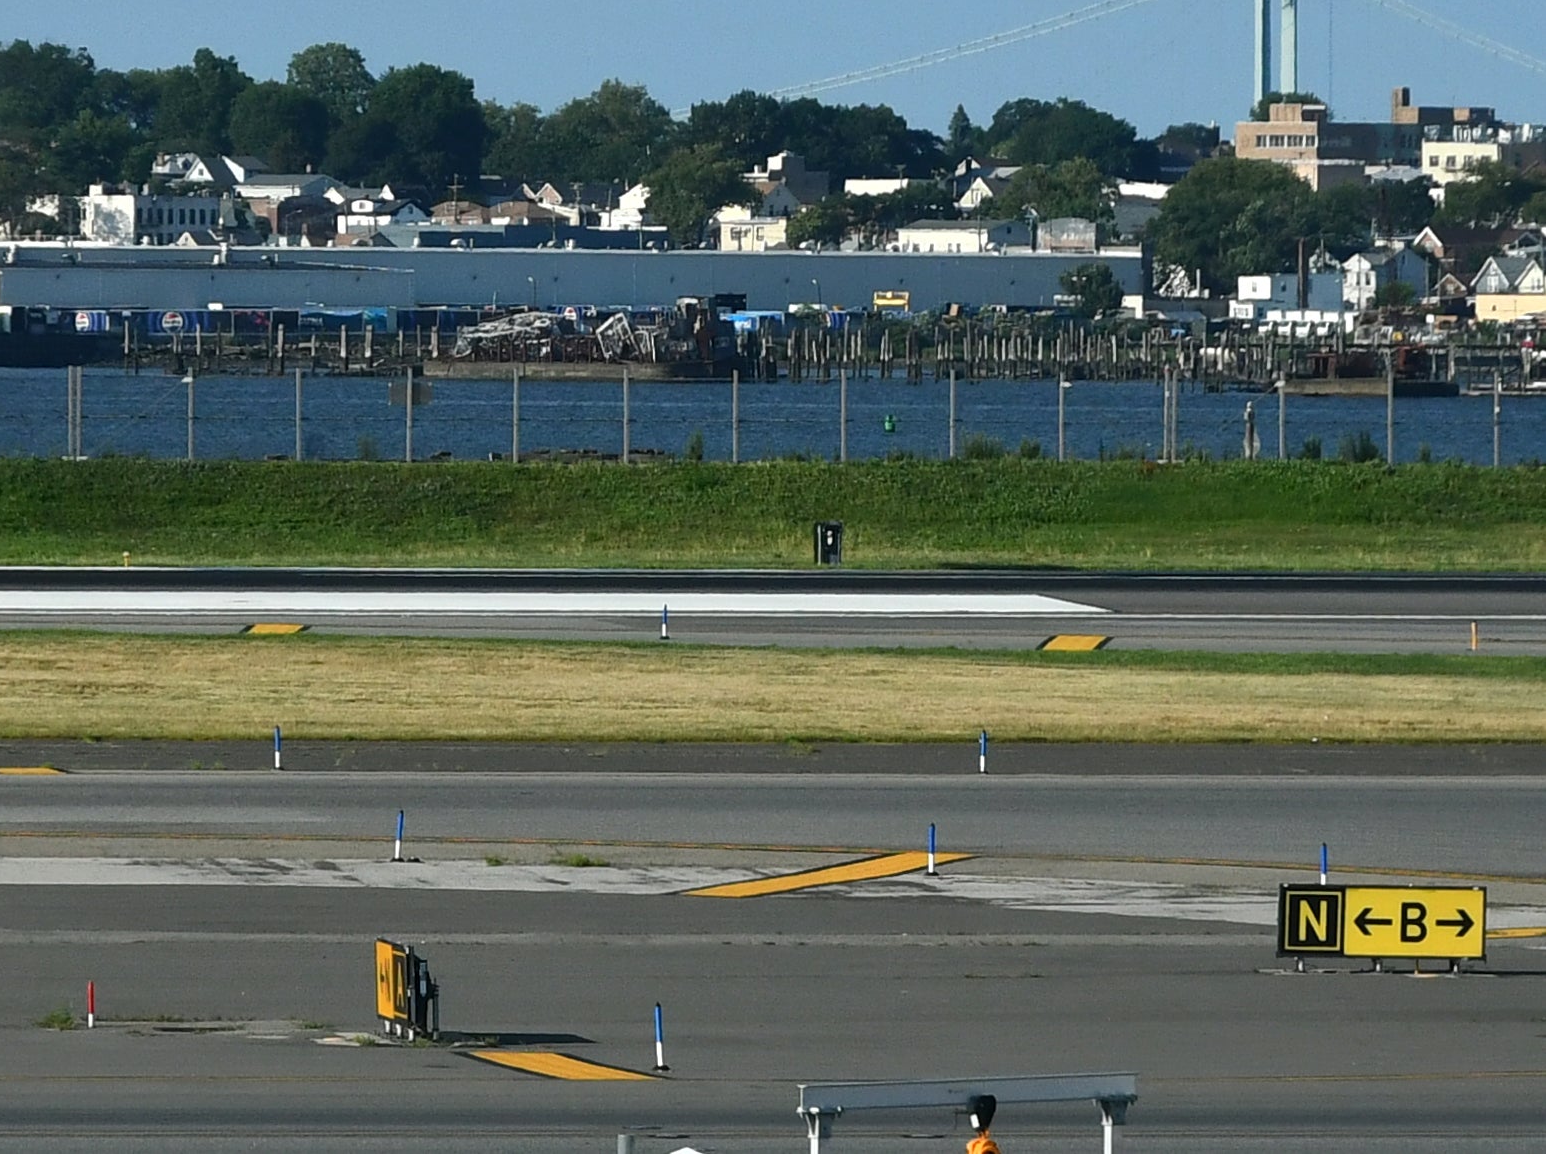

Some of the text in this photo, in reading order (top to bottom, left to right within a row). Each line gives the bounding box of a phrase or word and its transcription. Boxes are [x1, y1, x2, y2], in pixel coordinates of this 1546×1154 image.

[1298, 899, 1428, 943] N B
[396, 961, 405, 1008] A
